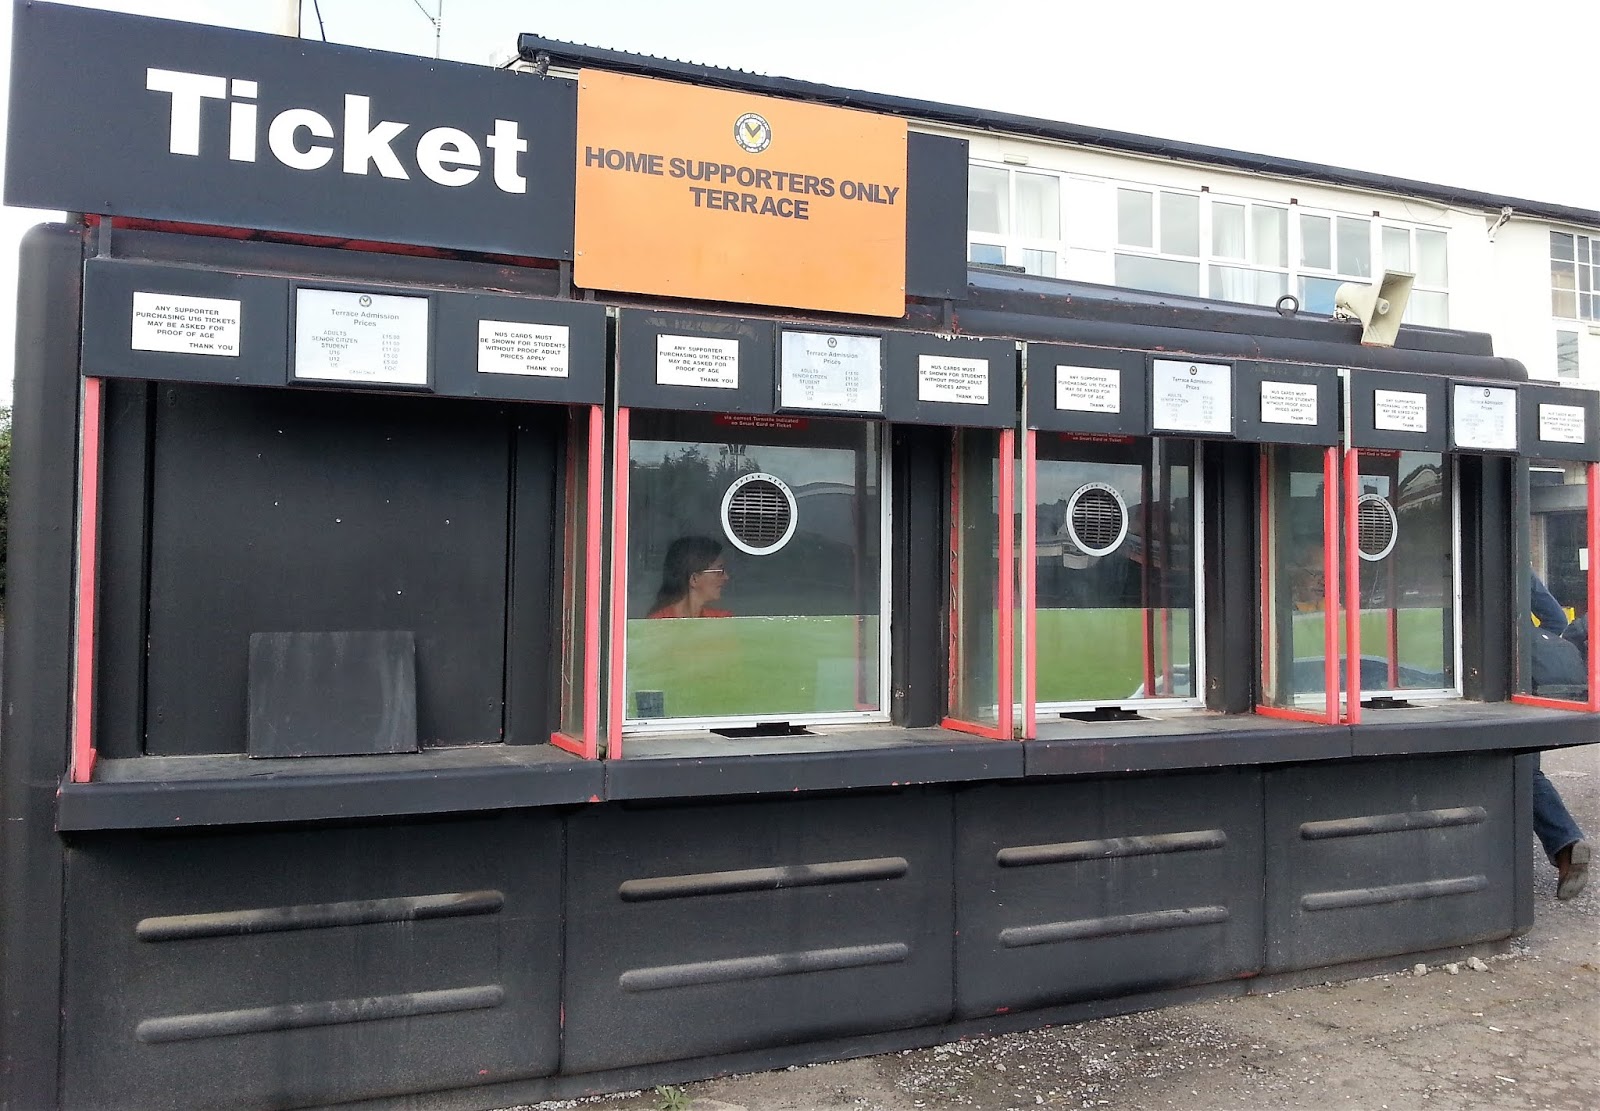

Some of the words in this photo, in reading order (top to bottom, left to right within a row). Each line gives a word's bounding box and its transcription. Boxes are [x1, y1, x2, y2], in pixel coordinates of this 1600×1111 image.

[146, 67, 528, 194] Ticket
[585, 146, 664, 176] HOME
[668, 157, 835, 198] SUPPORTERS
[839, 180, 900, 206] ONLY
[689, 186, 810, 220] TERRACE
[136, 312, 186, 321] PURCHASING
[174, 306, 219, 315] SUPPORTER
[331, 309, 359, 317] Terrace
[361, 311, 400, 320] Admission
